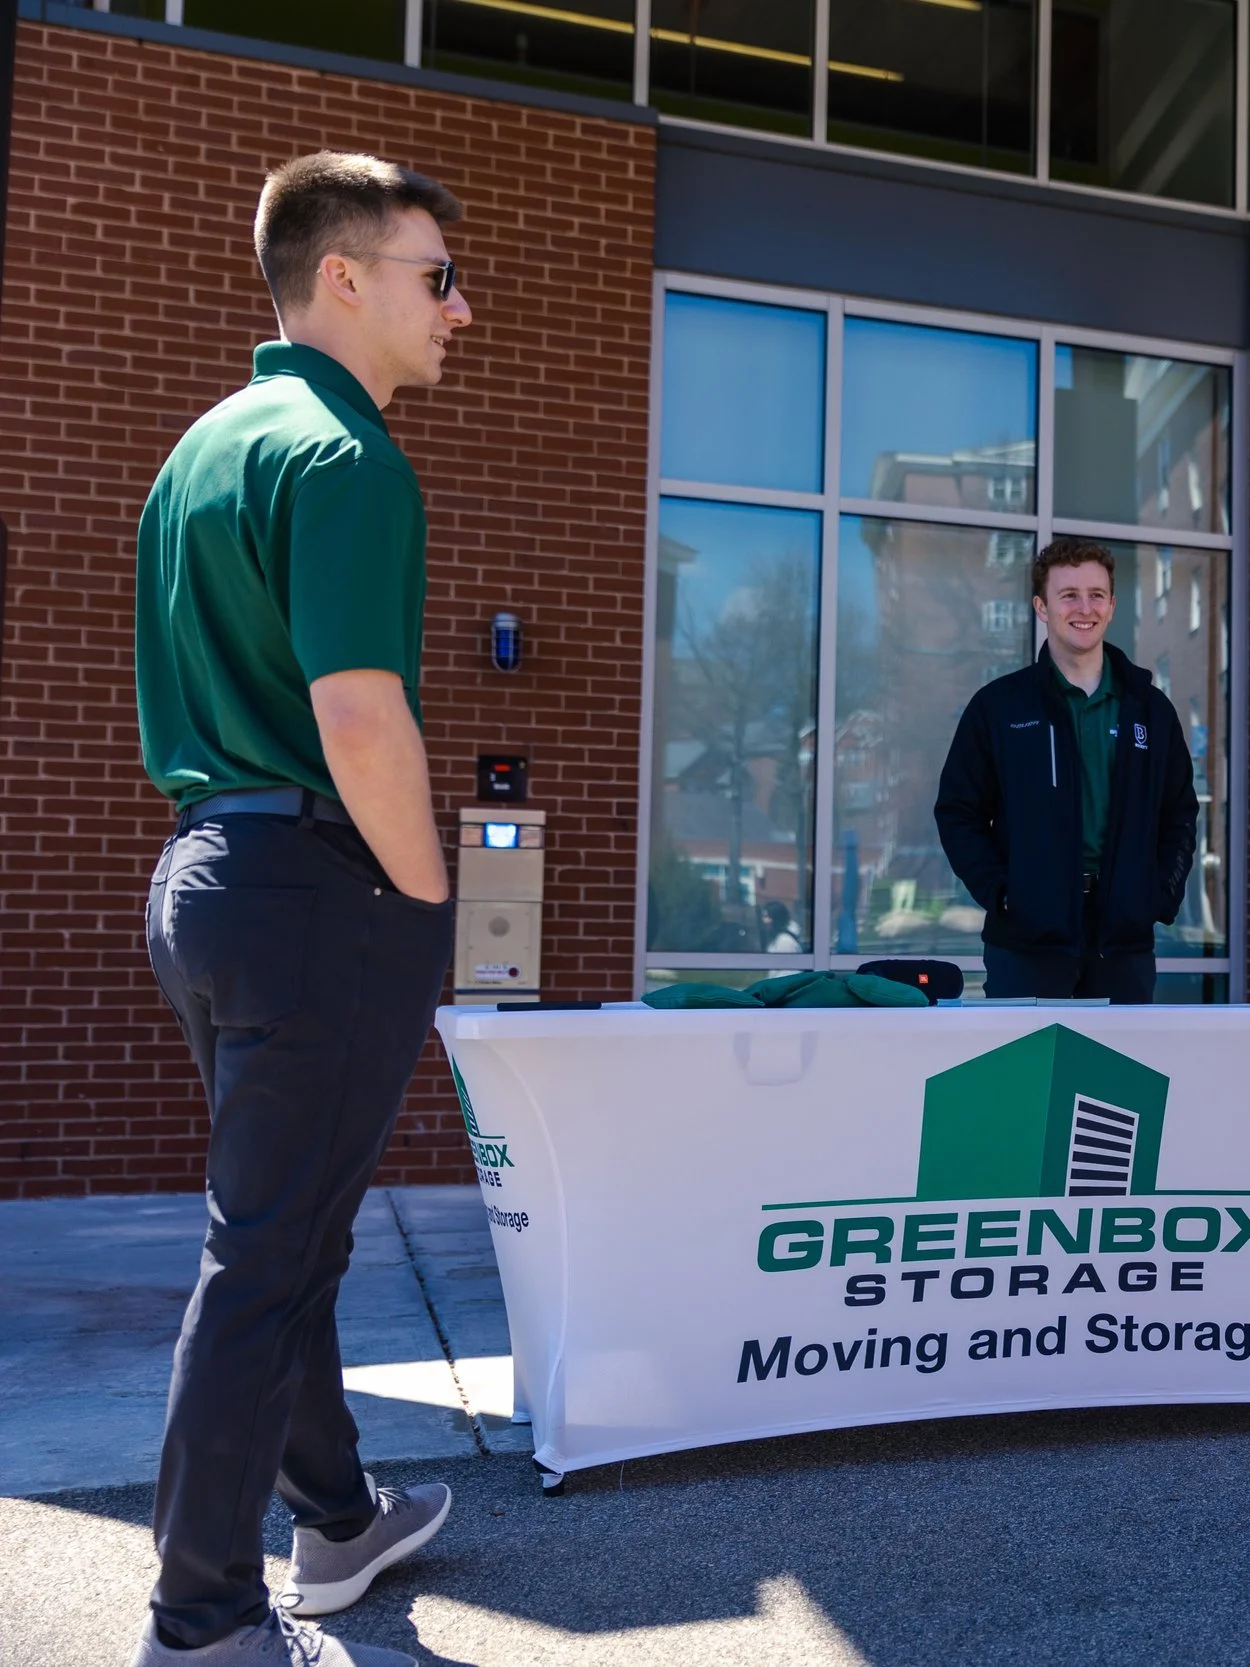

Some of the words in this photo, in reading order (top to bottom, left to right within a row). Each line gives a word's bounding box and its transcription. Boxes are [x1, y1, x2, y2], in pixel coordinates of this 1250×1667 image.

[844, 1261, 1204, 1307] STORAGE
[737, 1328, 948, 1384] Moving
[968, 1316, 1067, 1360] and
